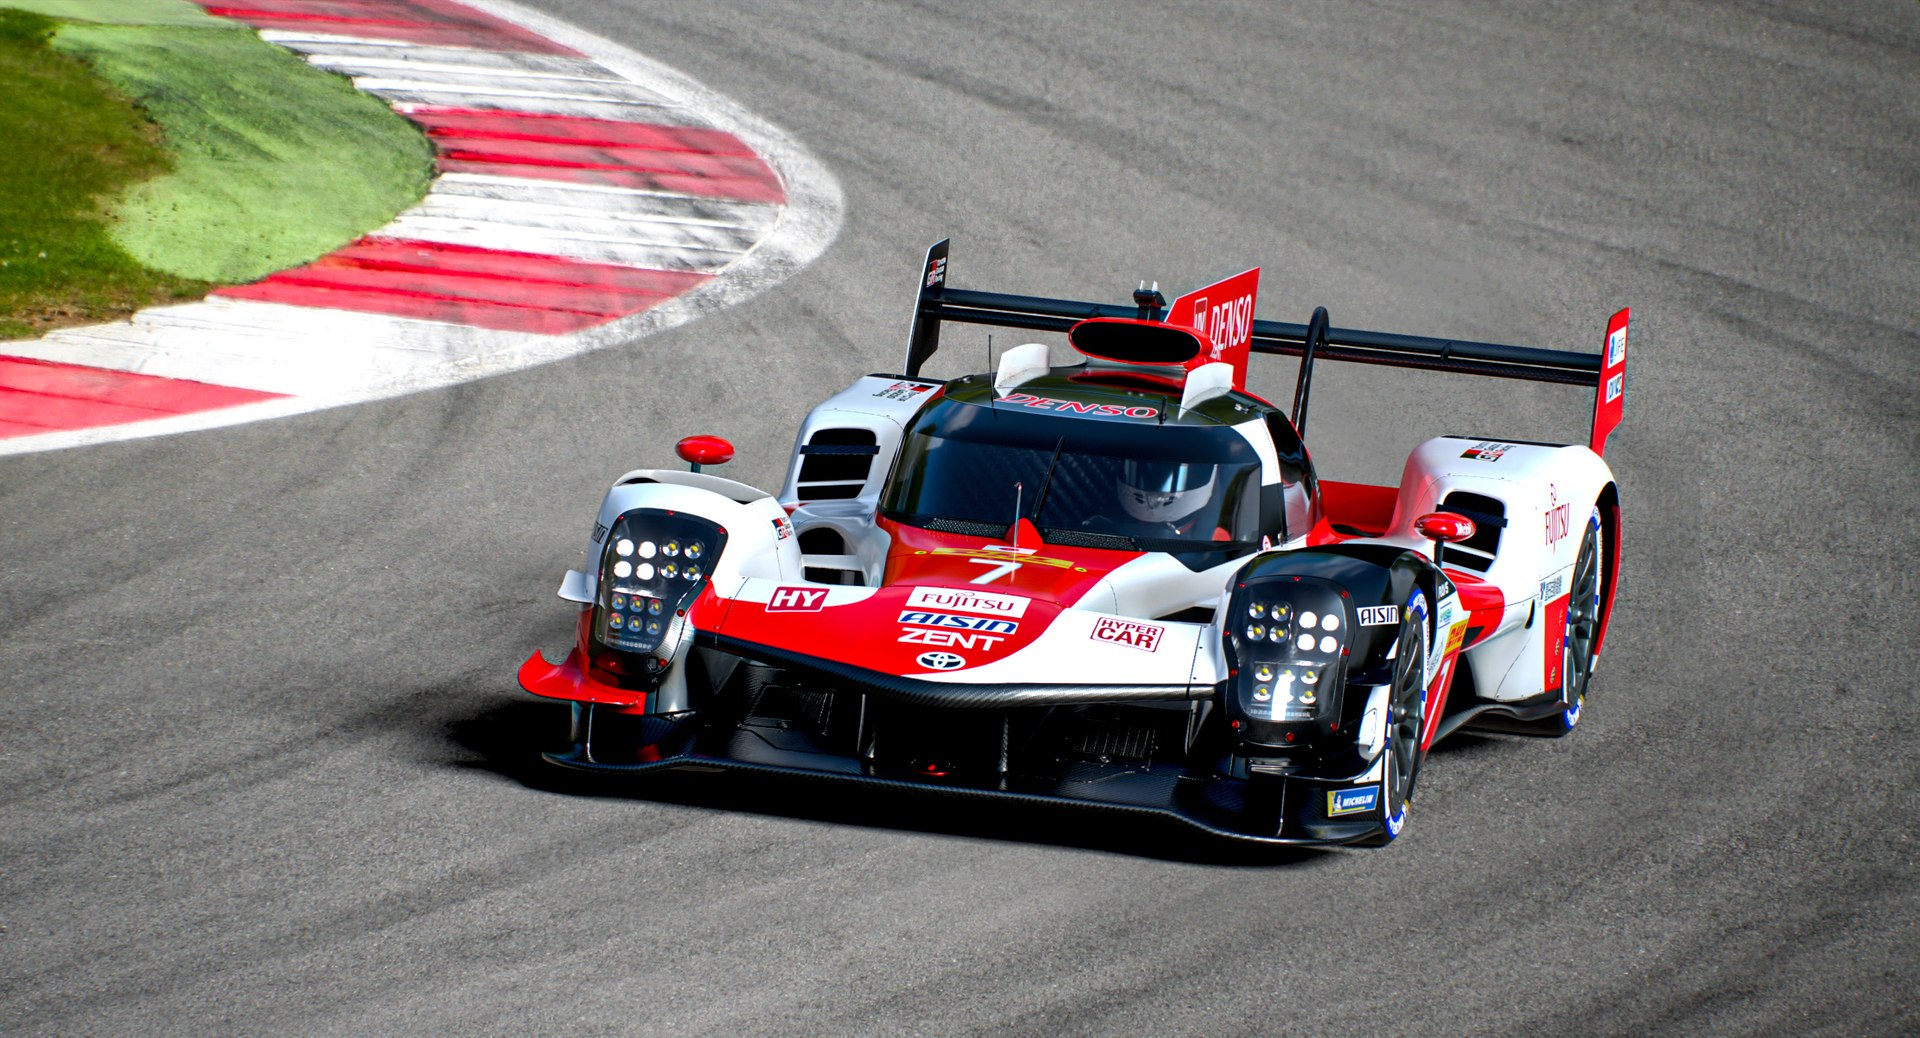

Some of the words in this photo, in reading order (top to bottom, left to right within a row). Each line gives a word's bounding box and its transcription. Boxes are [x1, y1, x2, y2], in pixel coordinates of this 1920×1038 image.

[1210, 294, 1252, 350] DENSO
[993, 393, 1159, 419] DENSO
[1545, 503, 1570, 554] FUJITSU
[969, 558, 1023, 585] 7
[771, 590, 826, 607] HY
[912, 593, 1014, 611] FUJITSU
[900, 612, 1017, 633] AISIN
[1361, 607, 1398, 624] AISIN
[1097, 627, 1154, 649] CAR
[1101, 620, 1158, 635] HYPER
[897, 628, 1004, 652] ZENT
[1343, 795, 1374, 807] MICHELIN
